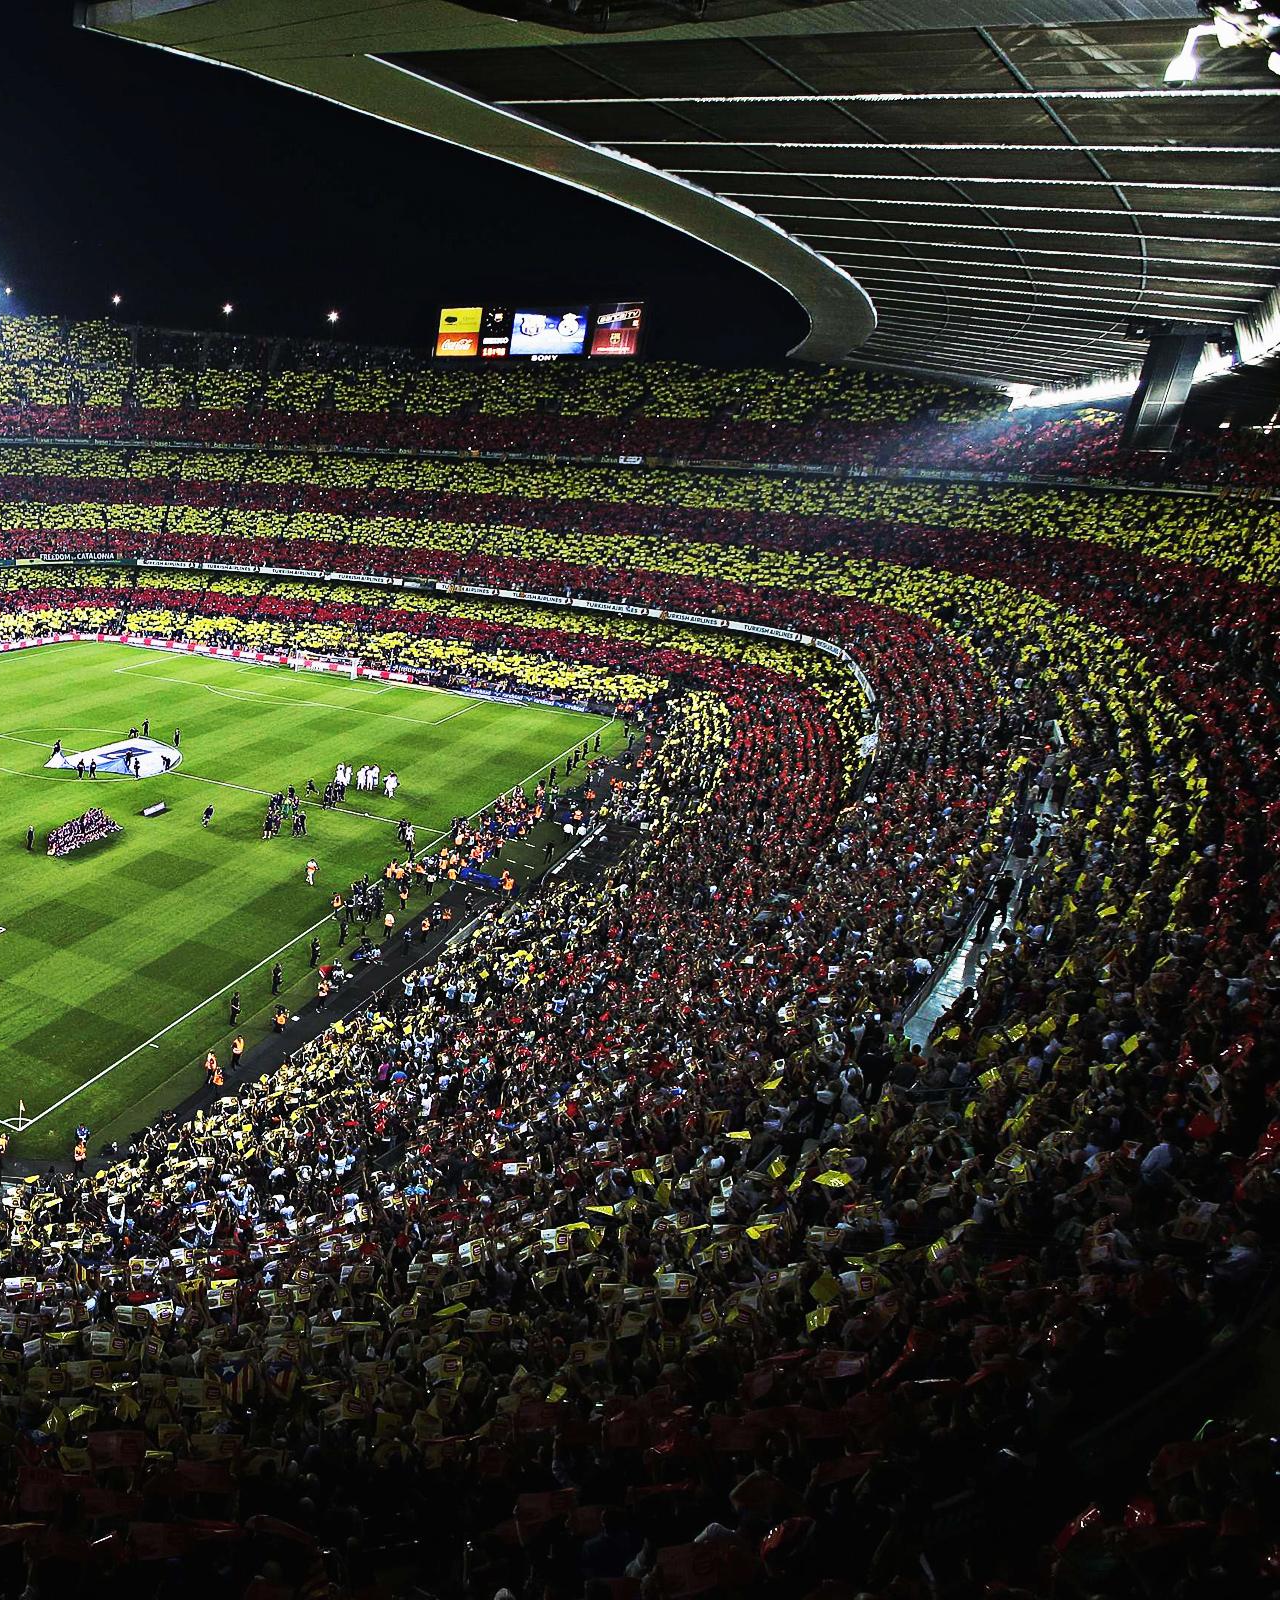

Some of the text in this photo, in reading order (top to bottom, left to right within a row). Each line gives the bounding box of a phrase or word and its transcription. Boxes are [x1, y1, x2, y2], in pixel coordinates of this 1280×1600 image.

[40, 553, 71, 561] FREEDOM
[76, 552, 115, 560] CATALONIA
[465, 586, 490, 594] AIRLINES
[586, 601, 611, 611] TURKISH
[690, 616, 718, 626] AIRLINES
[744, 624, 794, 639] TURKISH AIRLINES
